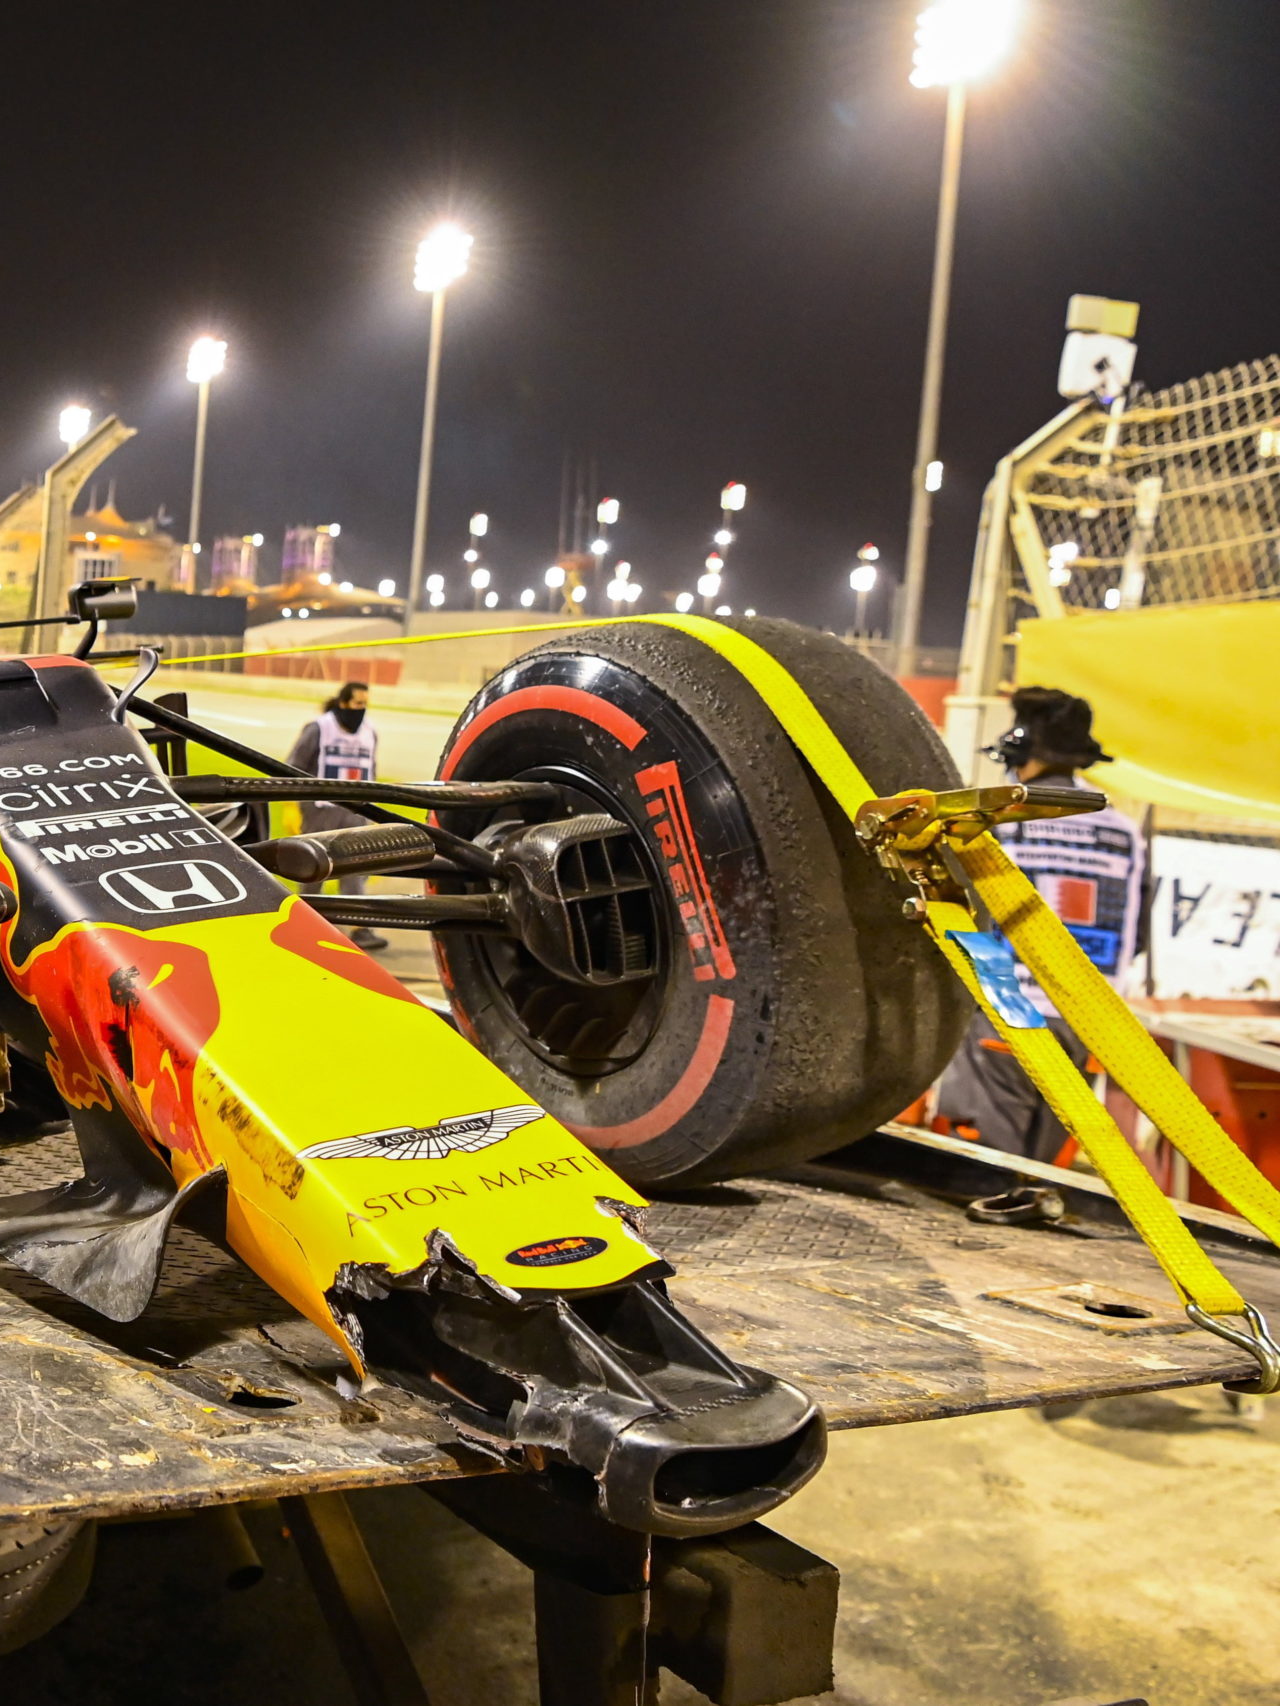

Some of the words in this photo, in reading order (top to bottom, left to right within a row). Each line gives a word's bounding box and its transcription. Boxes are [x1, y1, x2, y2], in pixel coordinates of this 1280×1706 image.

[15, 803, 190, 838] PIRELLI
[634, 760, 736, 981] PIRELLI
[383, 1130, 431, 1146] ASTON
[432, 1120, 485, 1137] MARTIN
[346, 1180, 468, 1238] ASTON
[478, 1154, 609, 1192] MARTI
